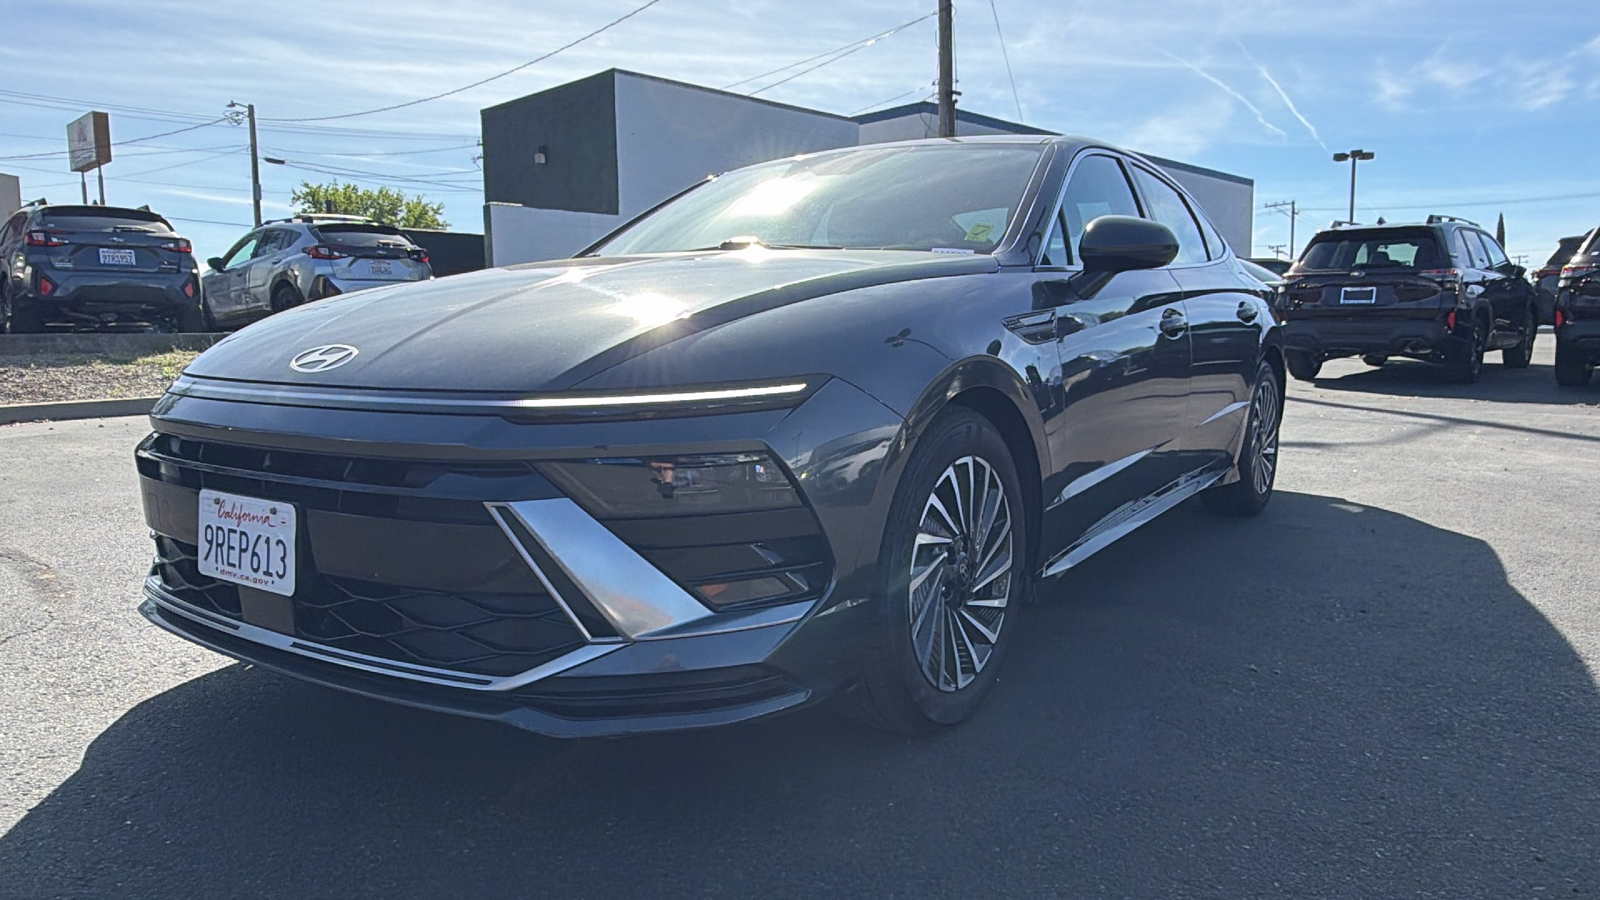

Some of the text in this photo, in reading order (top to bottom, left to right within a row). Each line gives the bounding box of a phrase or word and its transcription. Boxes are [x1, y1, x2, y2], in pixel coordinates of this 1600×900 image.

[217, 499, 277, 528] California
[204, 523, 287, 580] 9REP613
[219, 568, 269, 586] dmv.ca.gov
